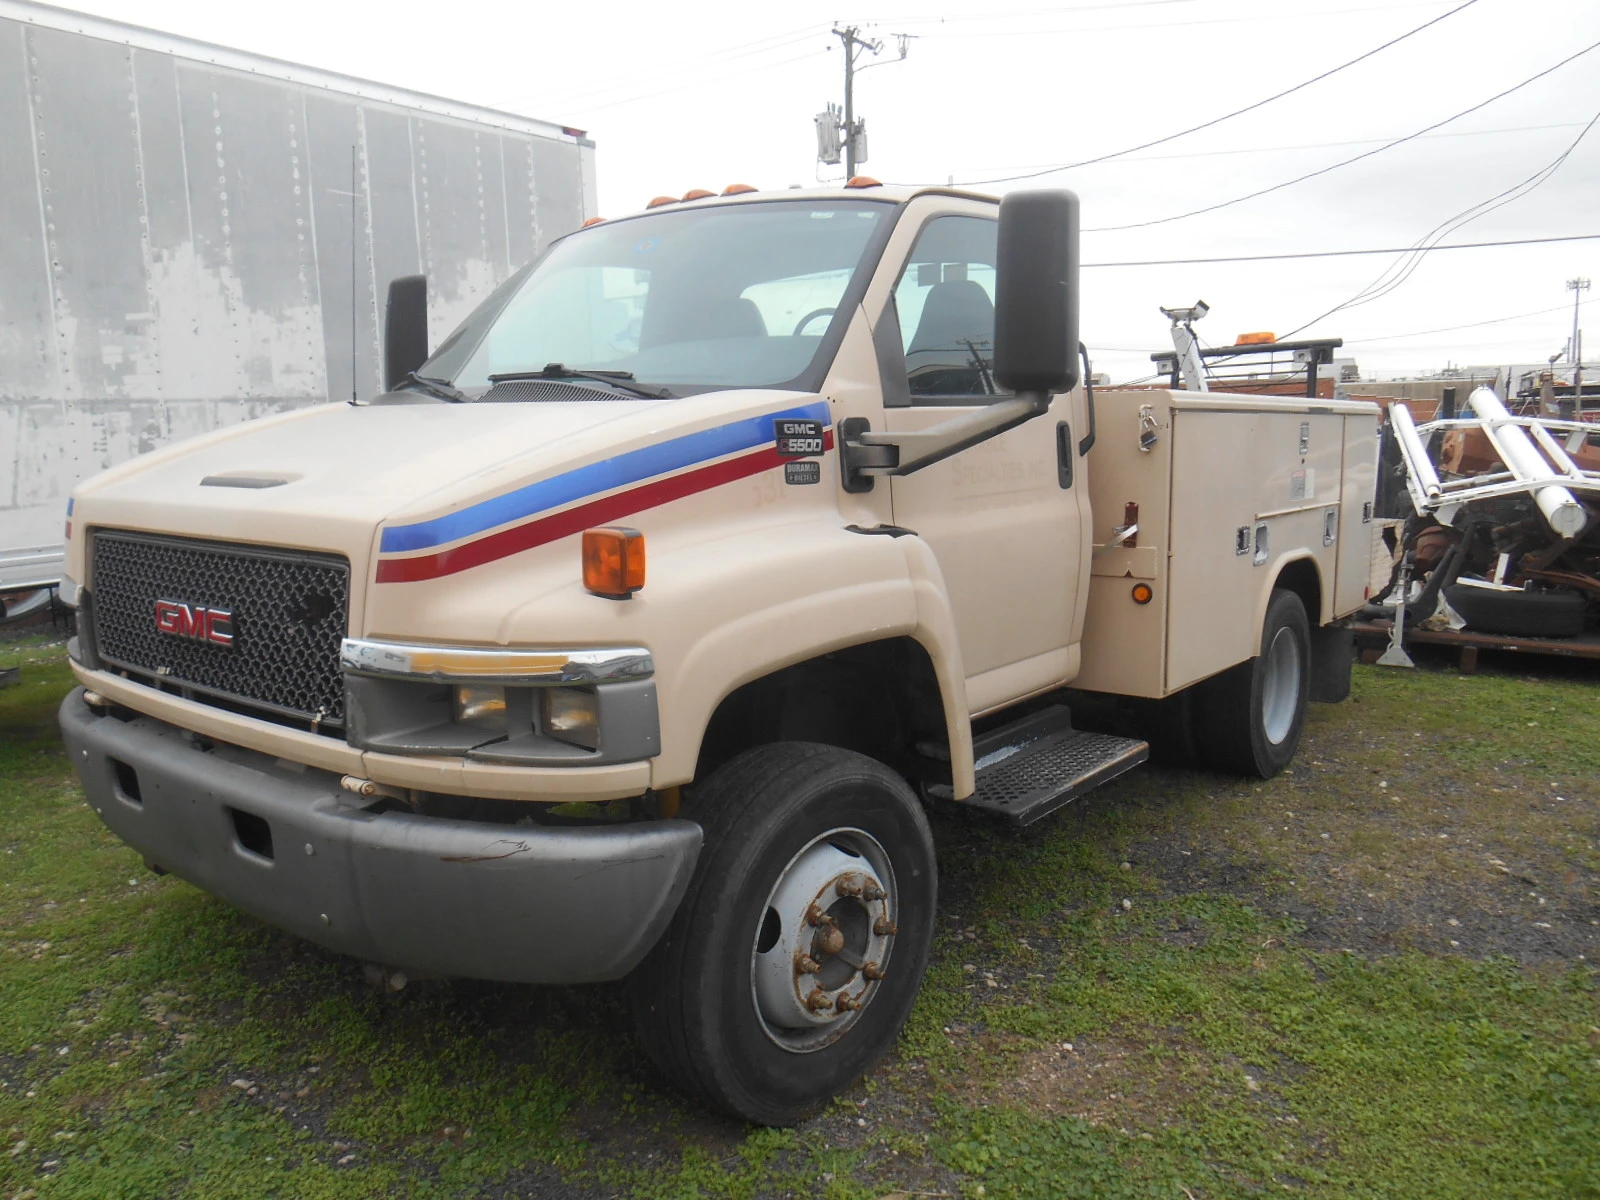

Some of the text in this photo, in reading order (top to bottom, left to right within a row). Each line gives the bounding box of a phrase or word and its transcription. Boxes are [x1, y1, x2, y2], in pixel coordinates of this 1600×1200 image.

[783, 423, 816, 435] GMC
[787, 463, 819, 473] DURAMAX
[156, 599, 234, 646] GMC
